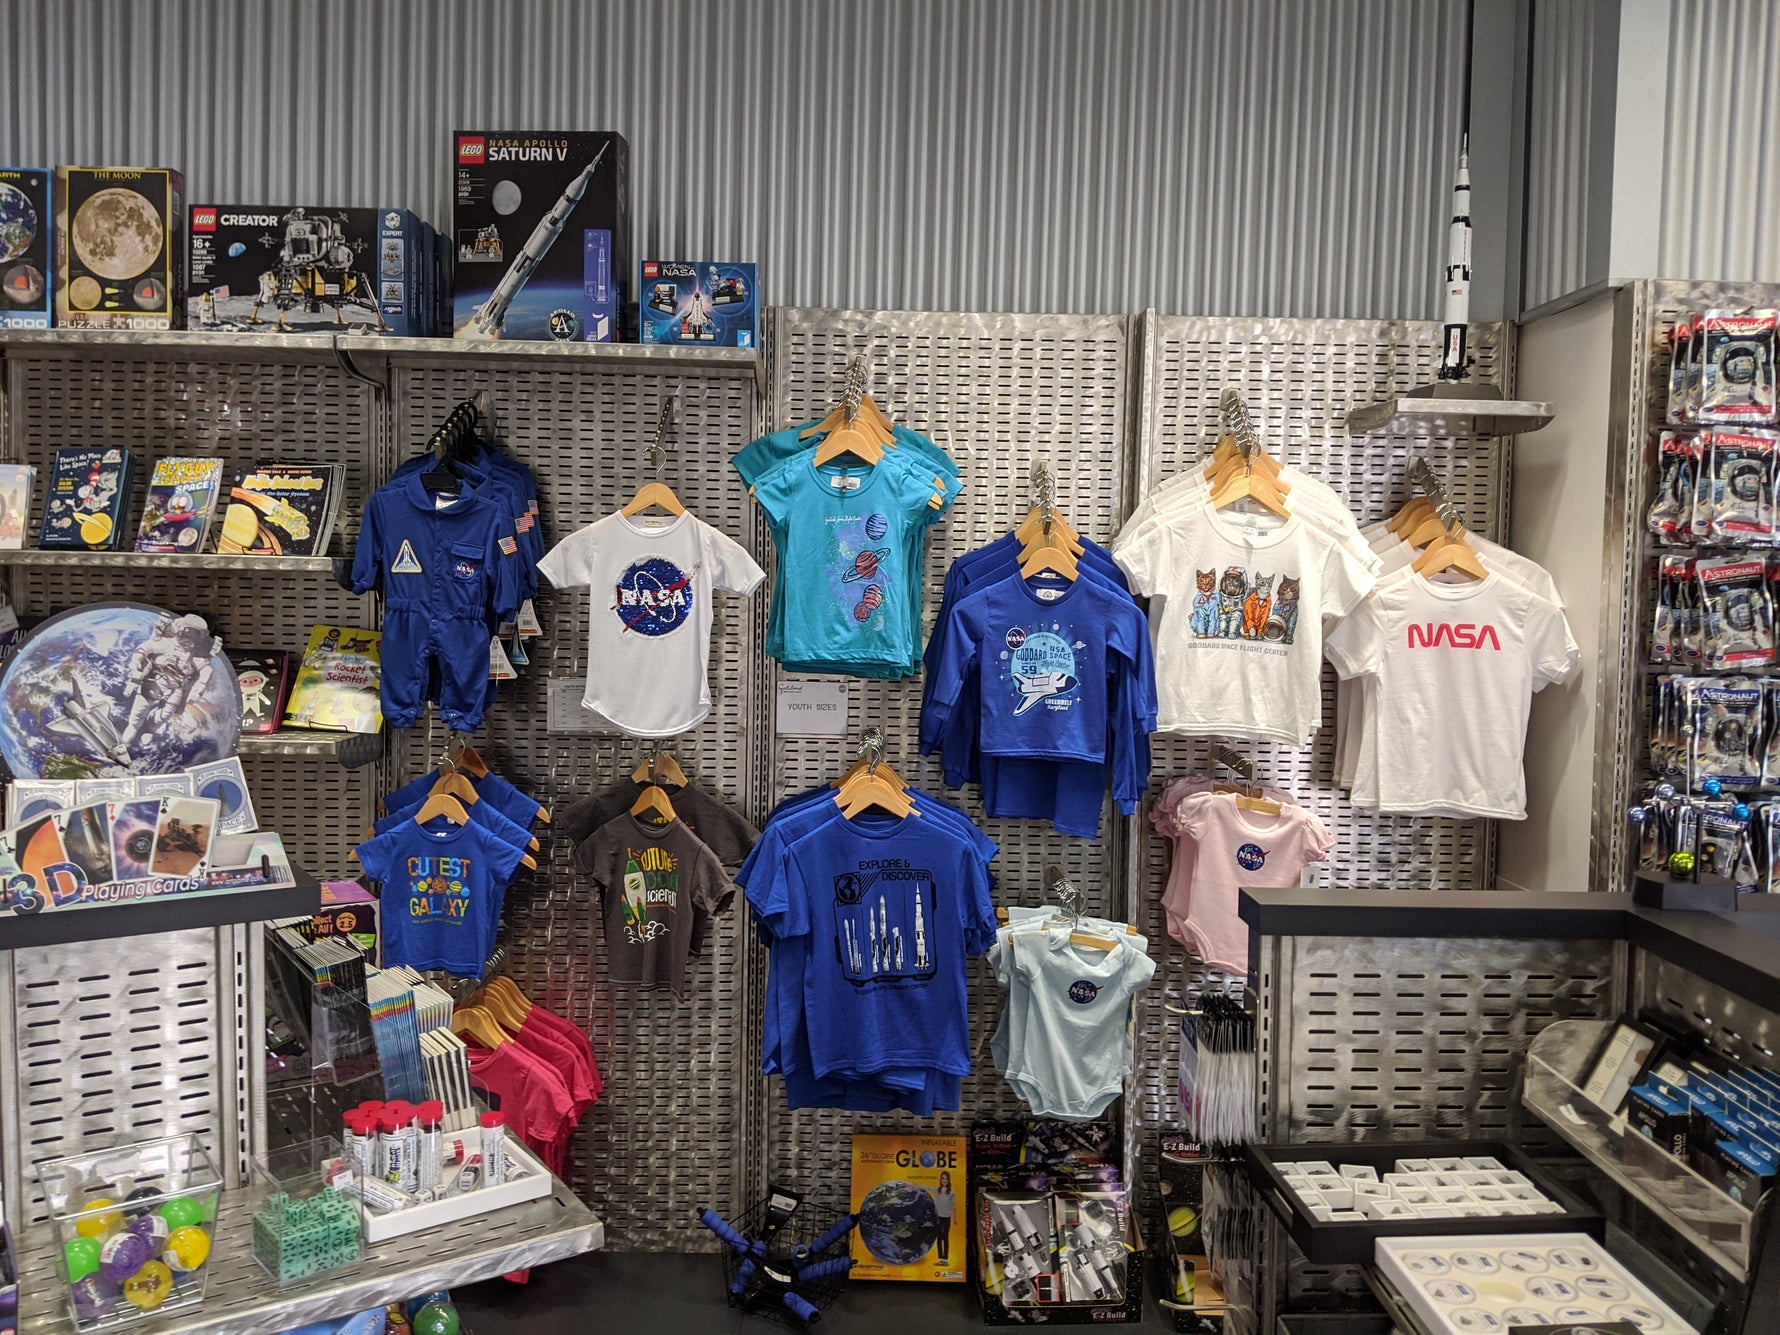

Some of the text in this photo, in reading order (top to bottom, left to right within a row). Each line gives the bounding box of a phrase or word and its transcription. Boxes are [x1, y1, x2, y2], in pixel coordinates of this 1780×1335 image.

[489, 139, 568, 148] NASA APOLLO
[461, 144, 483, 156] LEGO
[488, 147, 568, 161] SATURN V
[0, 172, 21, 180] ARTH
[93, 171, 142, 180] THE MOON
[195, 214, 215, 224] LEGO
[220, 214, 279, 227] CREATOR
[192, 238, 211, 249] 16+
[662, 268, 697, 277] NASA
[3, 317, 48, 329] 1000
[58, 318, 170, 330] PUZZLE 1000
[157, 462, 212, 475] FLY GUY
[175, 480, 210, 492] SPACE
[1704, 565, 1761, 579] ASTRONAUT
[620, 588, 686, 606] NASA
[1407, 622, 1502, 651] NASA
[1016, 647, 1048, 661] GODDARD
[1049, 645, 1071, 661] USA SPACE
[1220, 642, 1238, 651] SPACE
[1239, 644, 1263, 653] FLIGHT
[1264, 647, 1288, 657] CENTER
[333, 662, 367, 674] Rocket
[1021, 665, 1037, 675] 59
[325, 672, 369, 684] Scientist
[1701, 688, 1759, 701] ASTRONAUT
[787, 703, 837, 711] YOUTH SIZES
[162, 796, 170, 807] K
[108, 803, 116, 814] 7
[53, 814, 62, 825] 7
[0, 836, 8, 847] 7
[1239, 850, 1264, 864] NASA
[407, 856, 471, 878] CUTEST
[859, 859, 911, 870] EXPLORE &
[881, 871, 930, 881] DISCOVER
[7, 861, 89, 916] 3D
[81, 874, 200, 902] Playing Cards
[410, 896, 470, 917] GALAXY
[339, 921, 353, 929] 2.5
[1071, 986, 1095, 997] NASA
[1637, 1110, 1657, 1128] APOLLO
[920, 1139, 957, 1147] INFLATABLE
[975, 1133, 1012, 1142] E-Z Build
[1163, 1142, 1201, 1151] E-Z Build
[895, 1149, 957, 1169] GLOBE
[1726, 1170, 1748, 1190] APOLLO
[1106, 1311, 1126, 1319] Build
